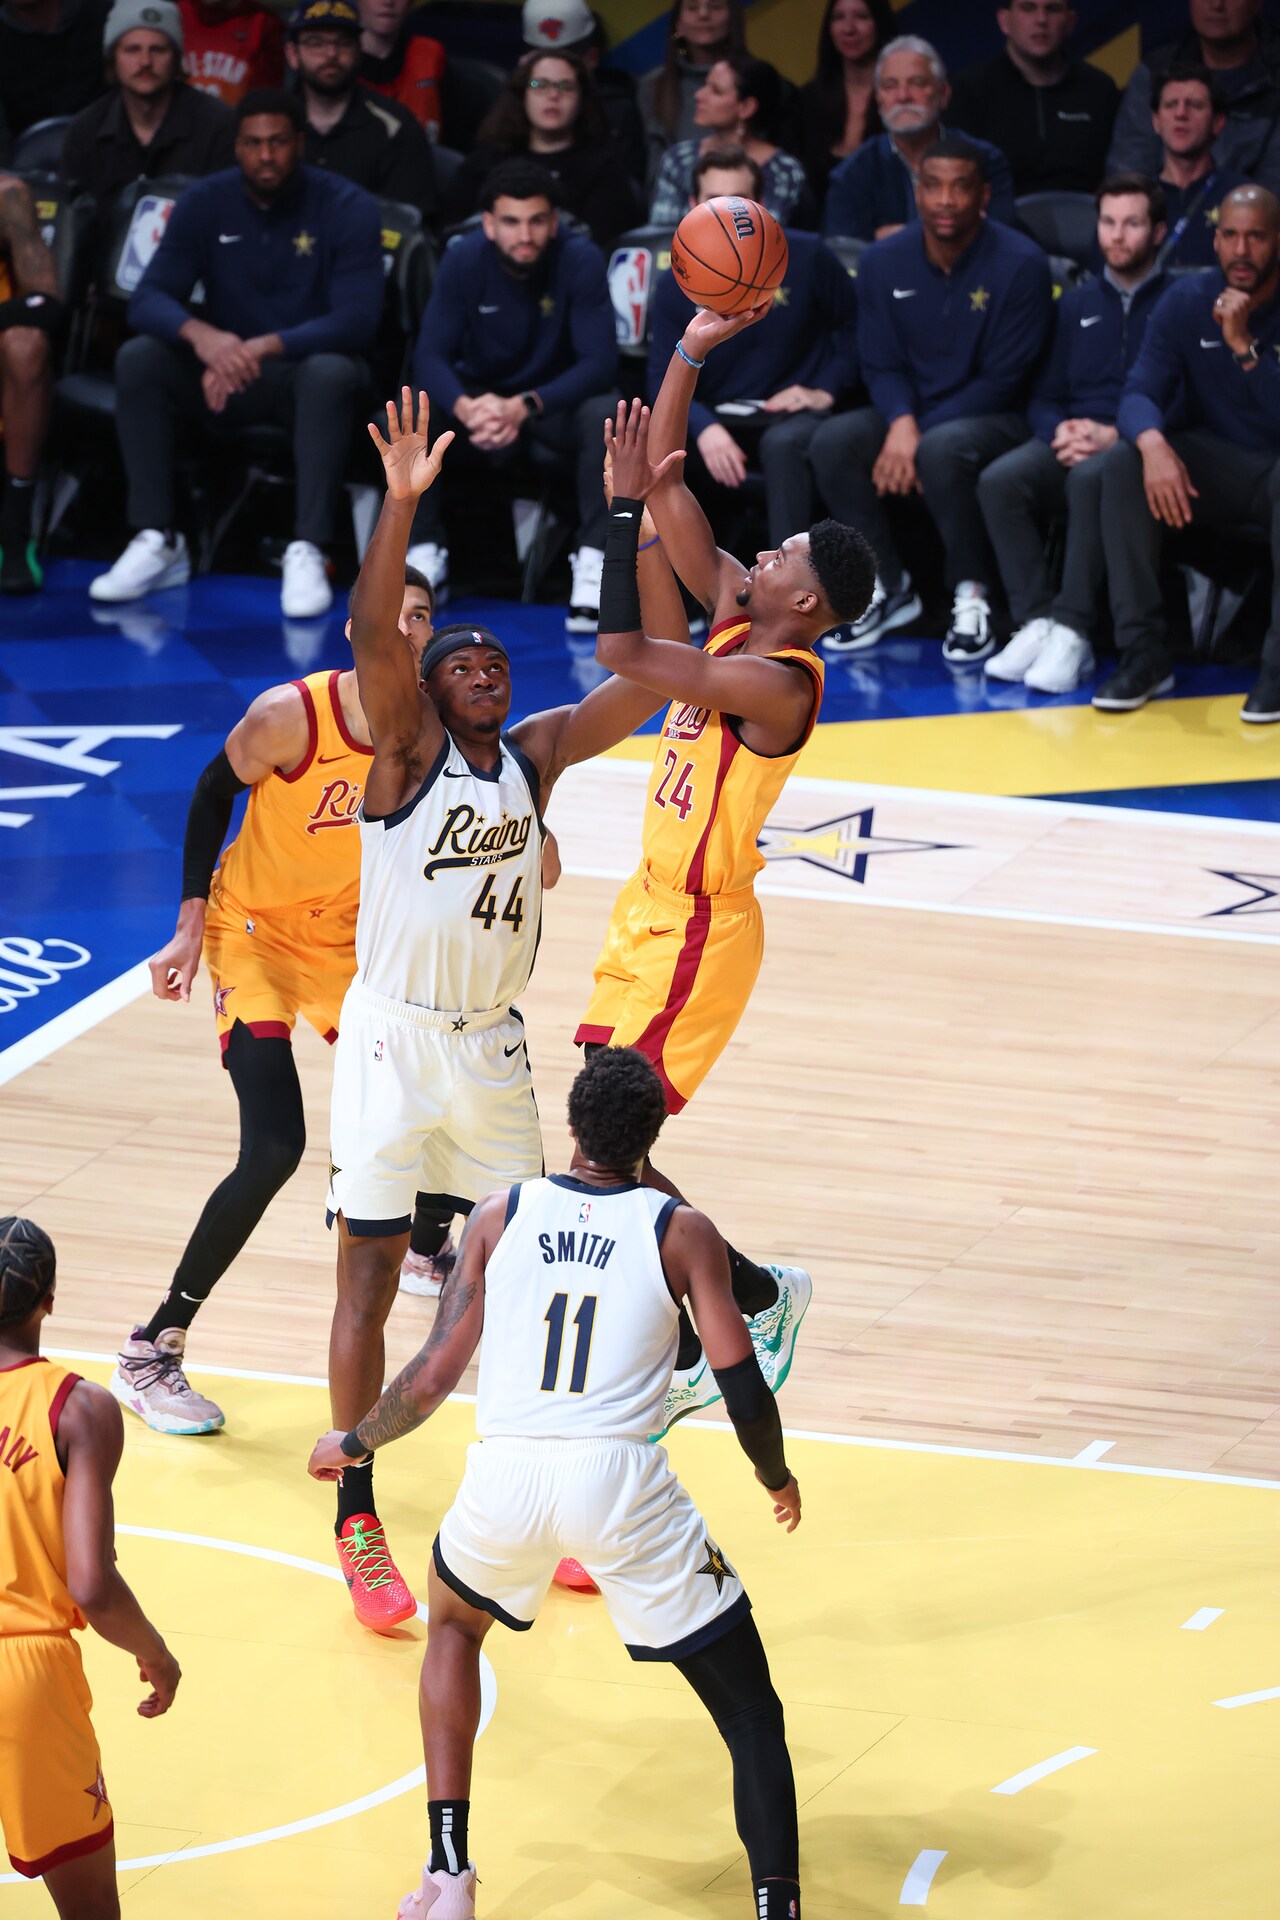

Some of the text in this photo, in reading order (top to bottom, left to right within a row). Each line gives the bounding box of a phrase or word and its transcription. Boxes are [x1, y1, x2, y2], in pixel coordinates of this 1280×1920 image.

[654, 747, 696, 823] 24
[428, 803, 534, 857] Rising
[469, 853, 504, 867] STARS
[470, 871, 524, 933] 44
[538, 1230, 617, 1270] SMITH
[539, 1291, 600, 1395] 11
